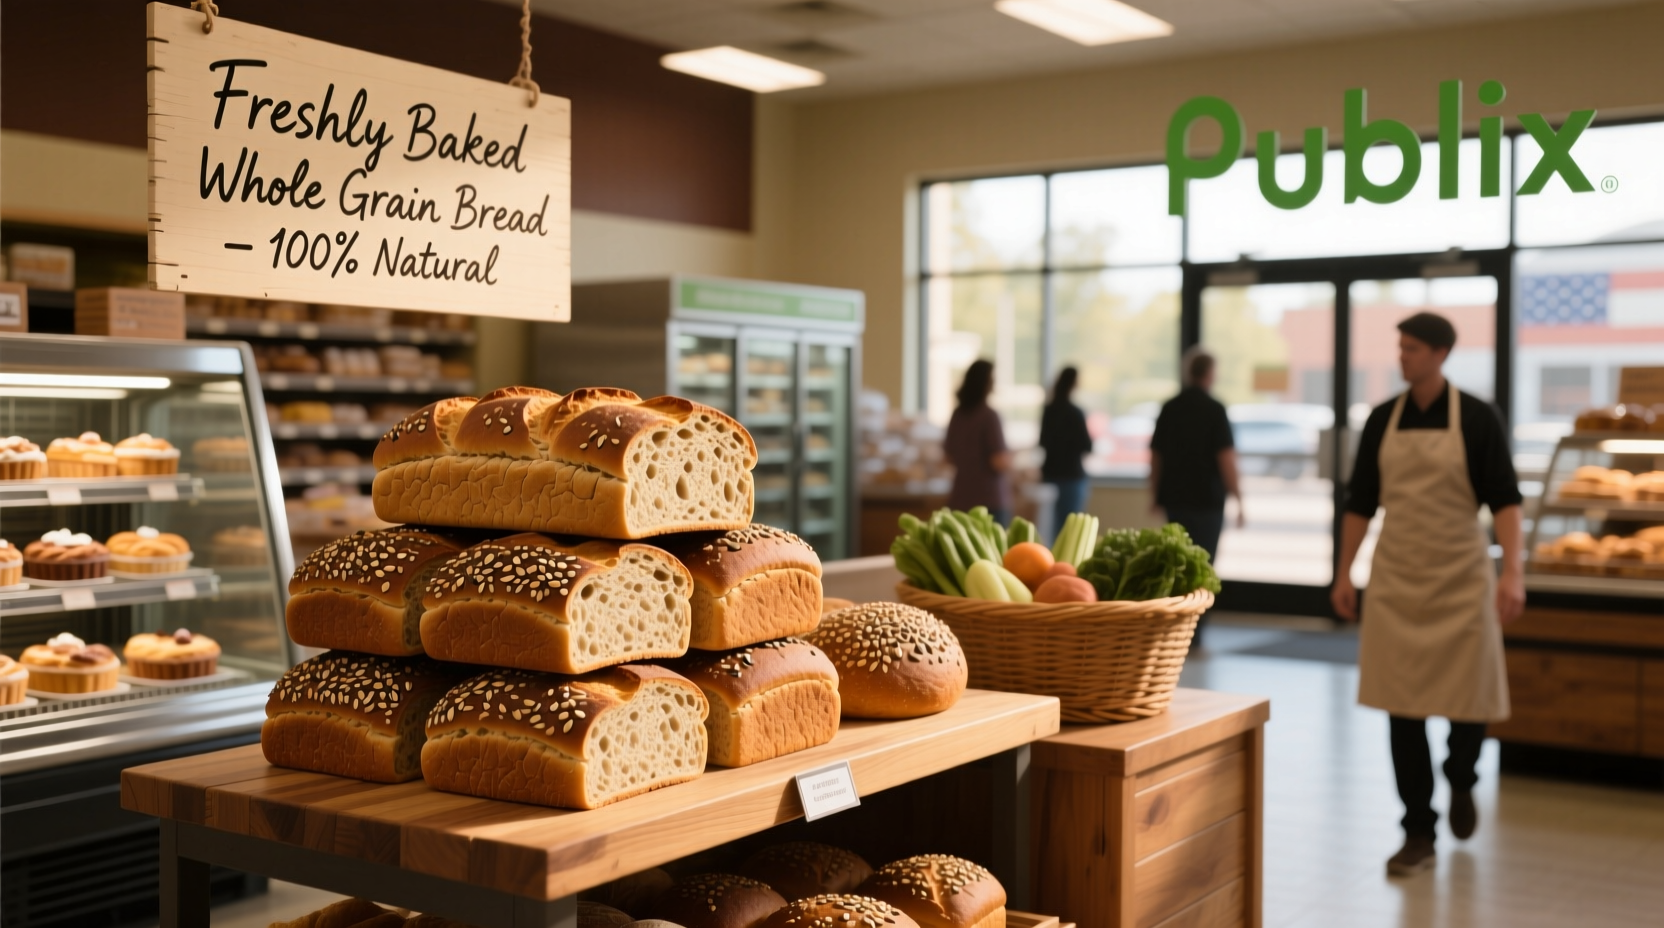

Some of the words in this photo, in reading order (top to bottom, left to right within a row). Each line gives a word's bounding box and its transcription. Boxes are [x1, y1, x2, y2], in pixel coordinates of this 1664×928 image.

[209, 58, 395, 173] Freshly
[402, 103, 529, 174] Baked
[1165, 79, 1597, 217] Publix
[199, 145, 327, 210] Whole
[339, 168, 442, 222] Grain
[450, 183, 550, 237] Bread
[269, 227, 360, 280] 100%
[372, 236, 500, 286] Natural
